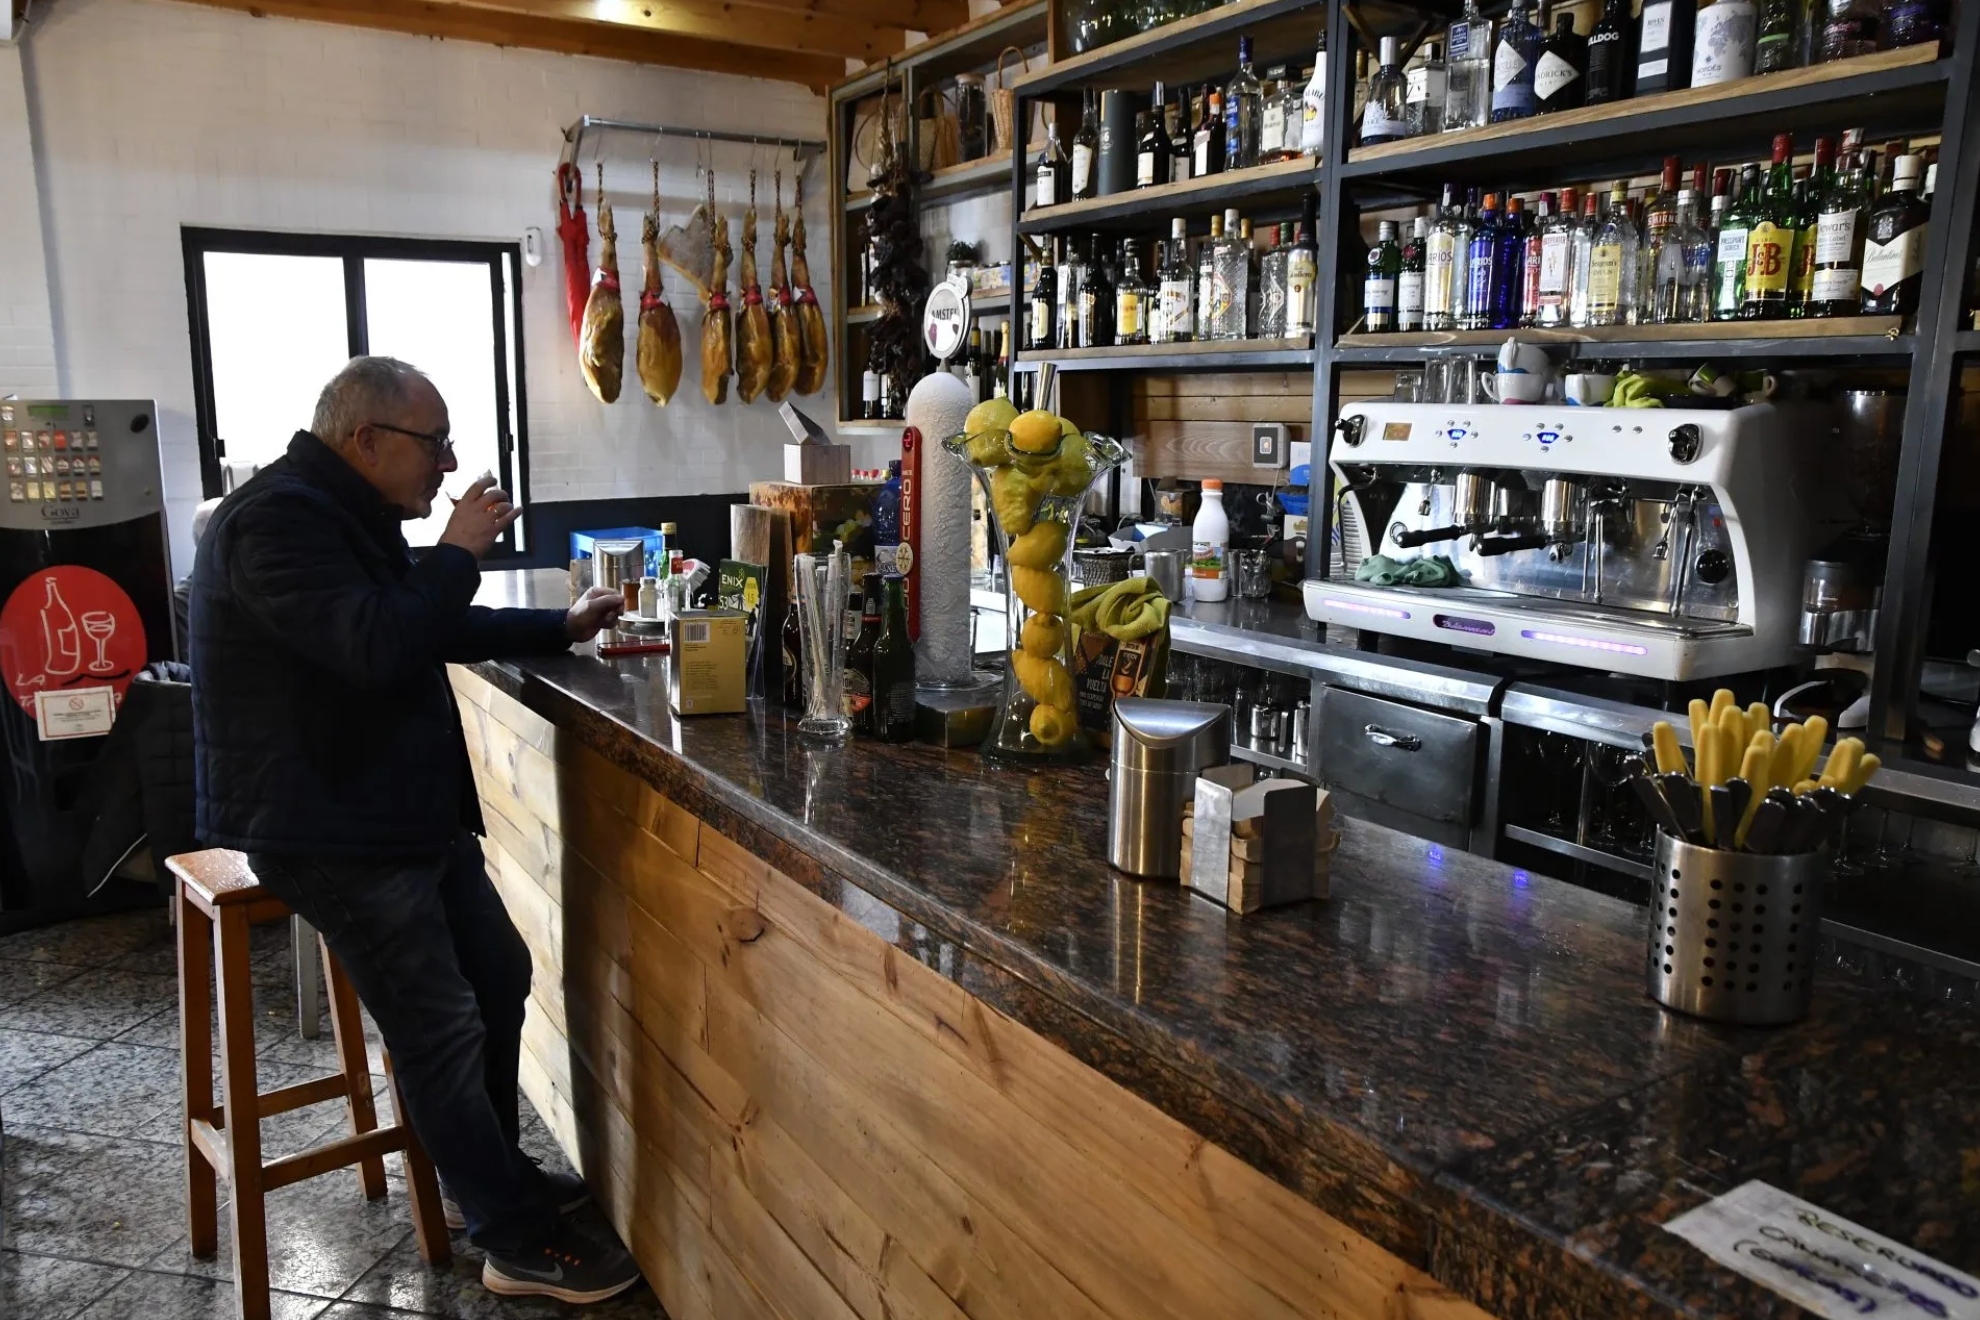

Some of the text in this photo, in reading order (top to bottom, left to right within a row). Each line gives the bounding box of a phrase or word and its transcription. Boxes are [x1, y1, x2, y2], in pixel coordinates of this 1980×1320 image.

[1647, 213, 1677, 225] SMIRN
[1428, 250, 1453, 262] ARIOS
[902, 478, 911, 541] CERO
